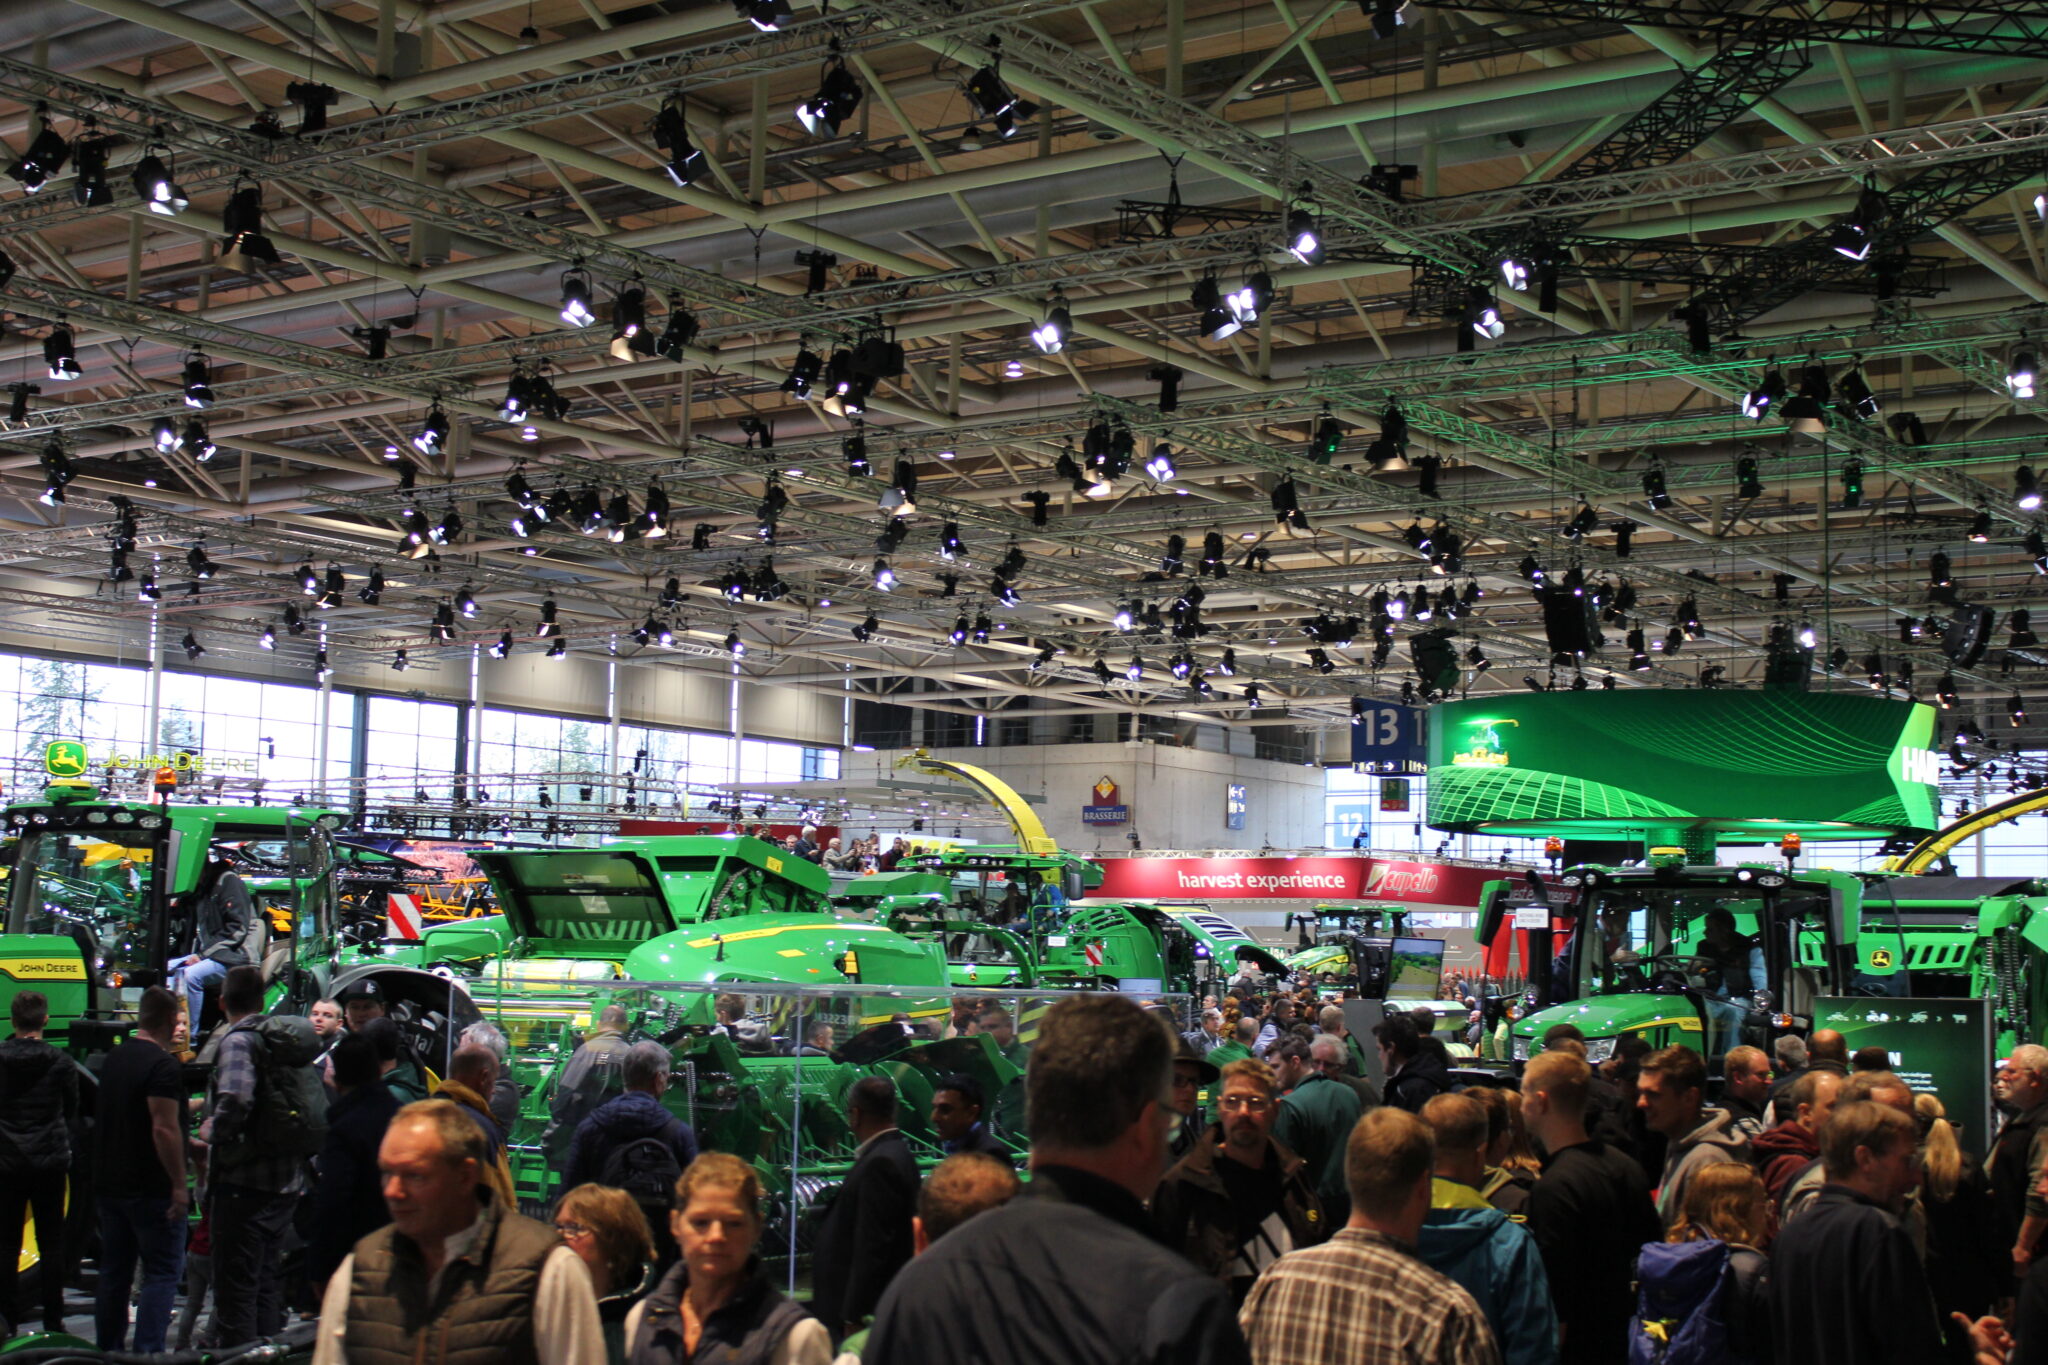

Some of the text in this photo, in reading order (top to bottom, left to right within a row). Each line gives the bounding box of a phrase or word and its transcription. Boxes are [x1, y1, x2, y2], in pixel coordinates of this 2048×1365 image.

[1362, 708, 1399, 746] 13
[1414, 709, 1428, 746] 1
[100, 750, 258, 772] JOHN DEERE
[1084, 811, 1126, 820] BRASSERIE
[1339, 812, 1364, 838] 12
[1177, 870, 1346, 893] harvest experience
[18, 963, 79, 973] JOHN DEERE
